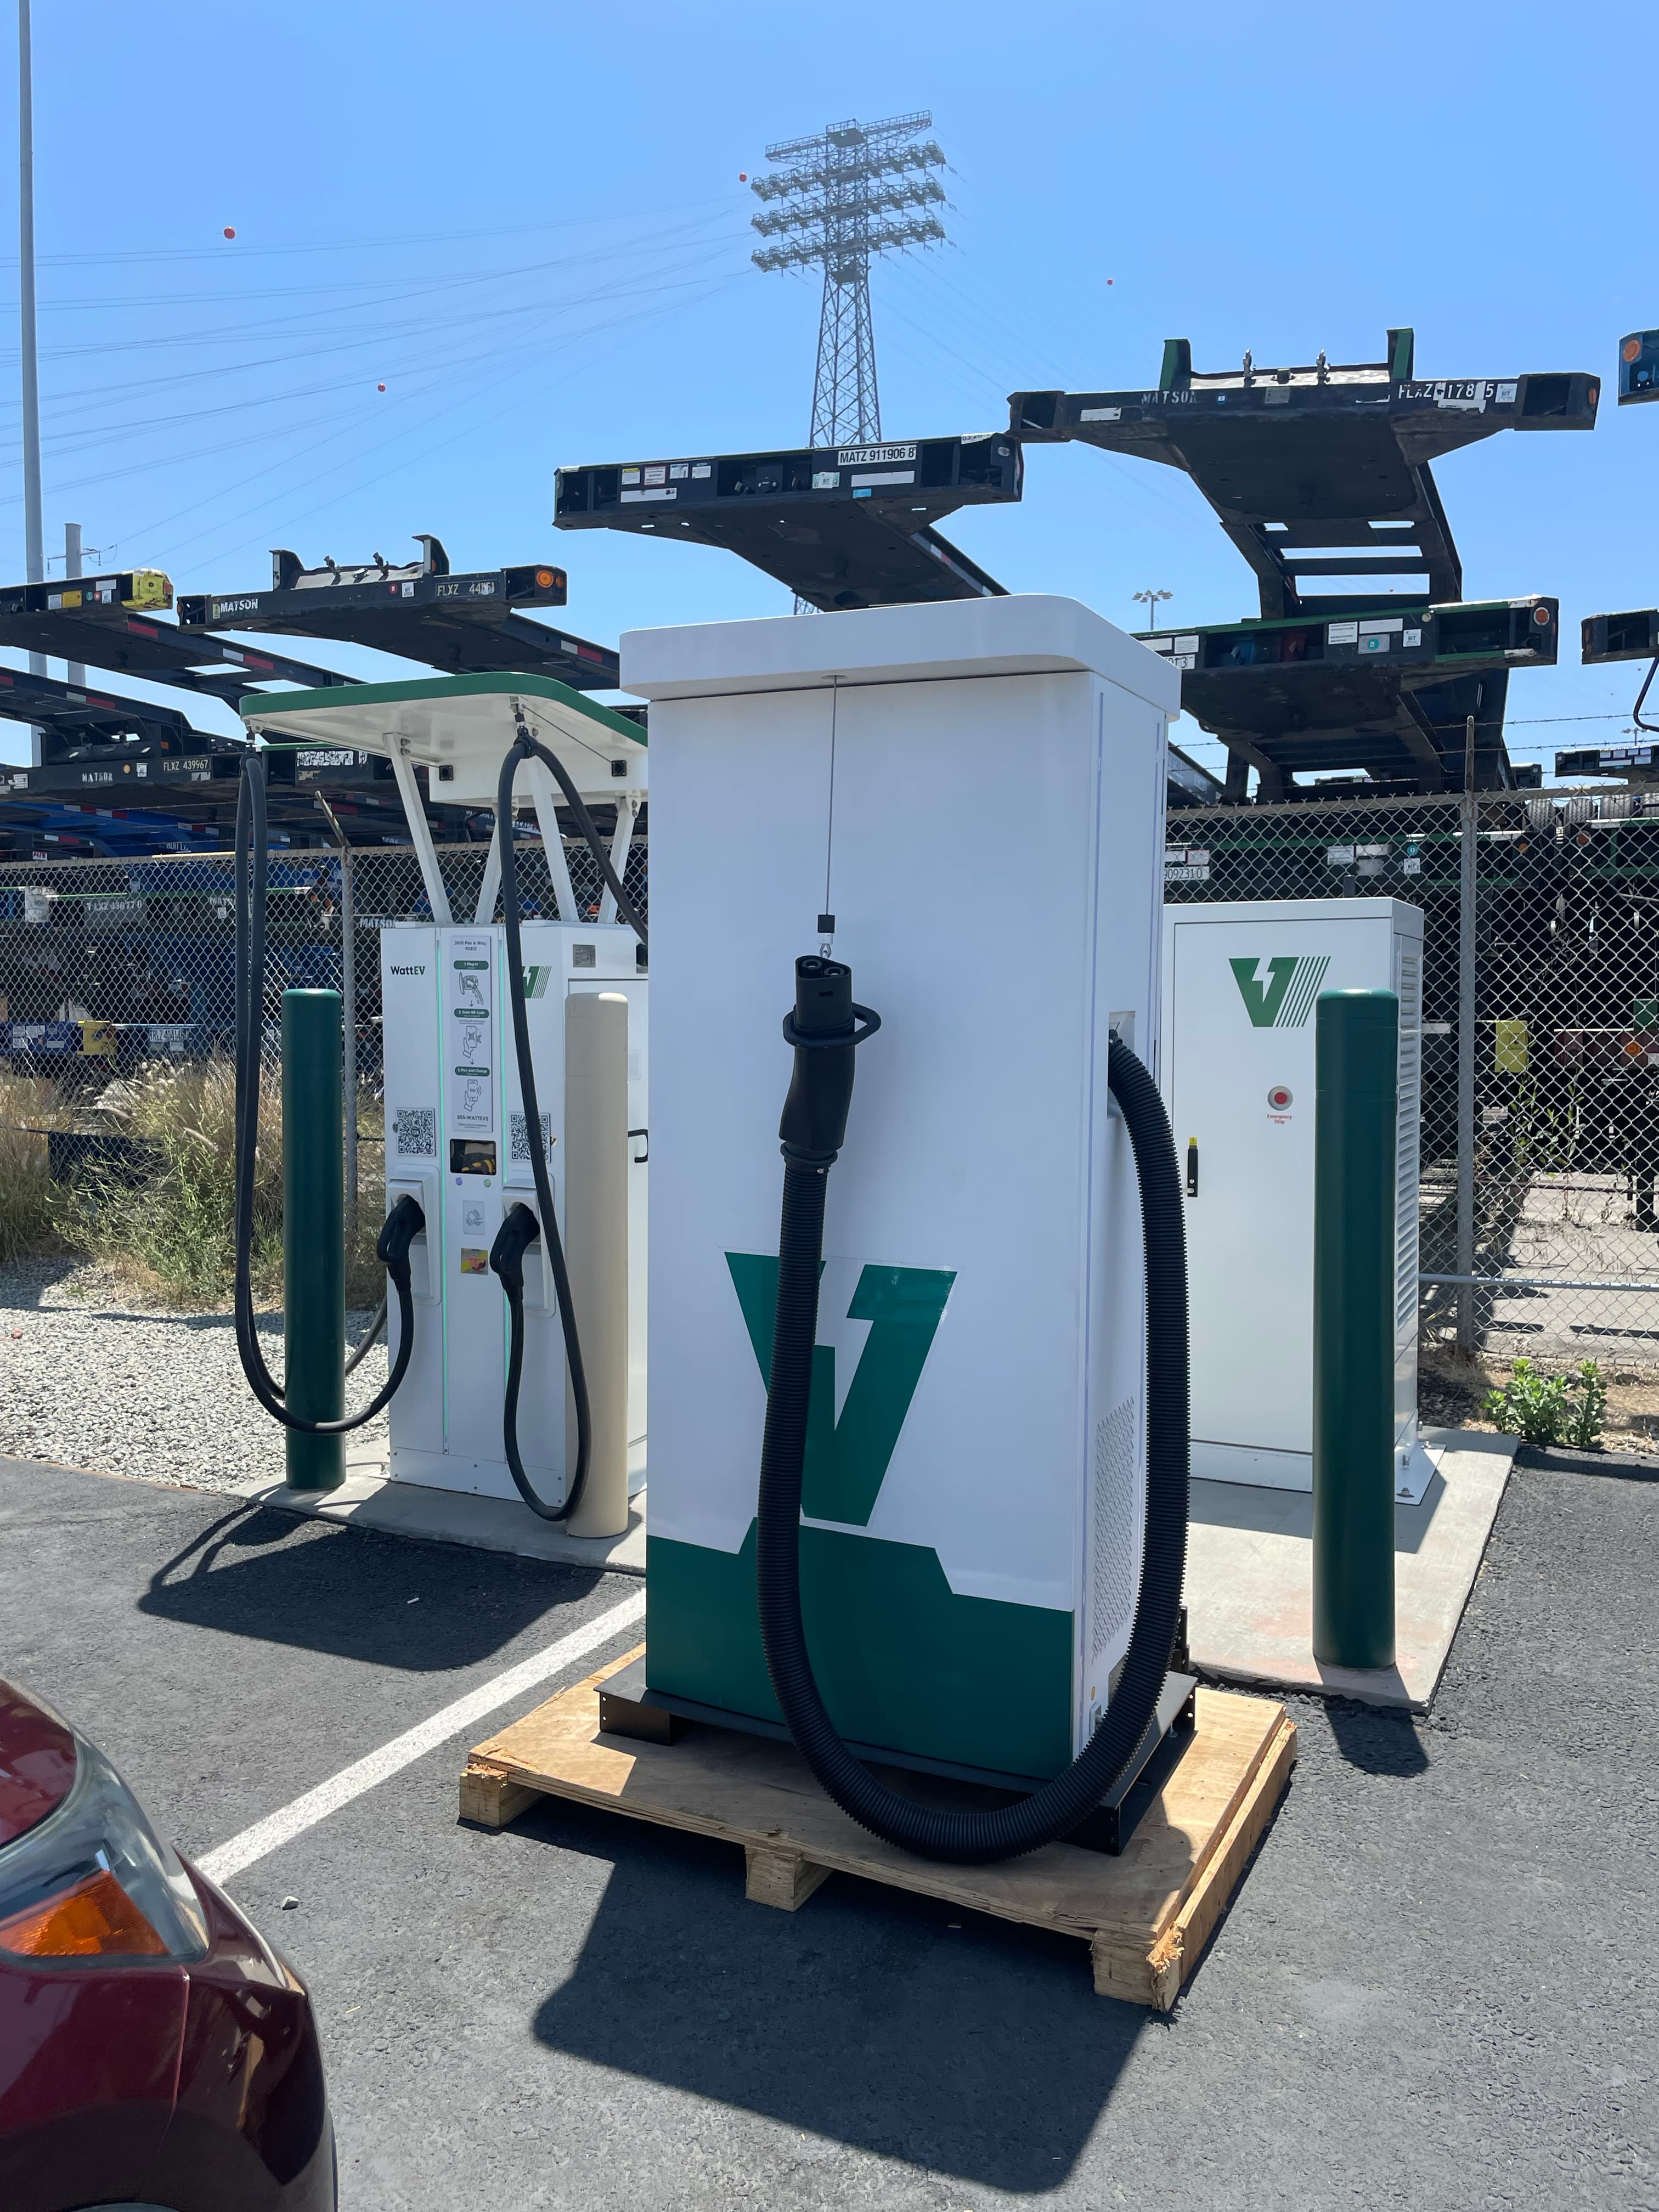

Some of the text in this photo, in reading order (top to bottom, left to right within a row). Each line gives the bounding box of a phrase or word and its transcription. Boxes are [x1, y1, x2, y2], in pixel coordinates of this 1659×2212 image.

[840, 447, 915, 464] MATZ 911906 8
[437, 584, 460, 597] FLXZ
[221, 599, 258, 613] MATSON
[163, 759, 208, 771] FLXZ 439967
[390, 966, 426, 975] WattEV
